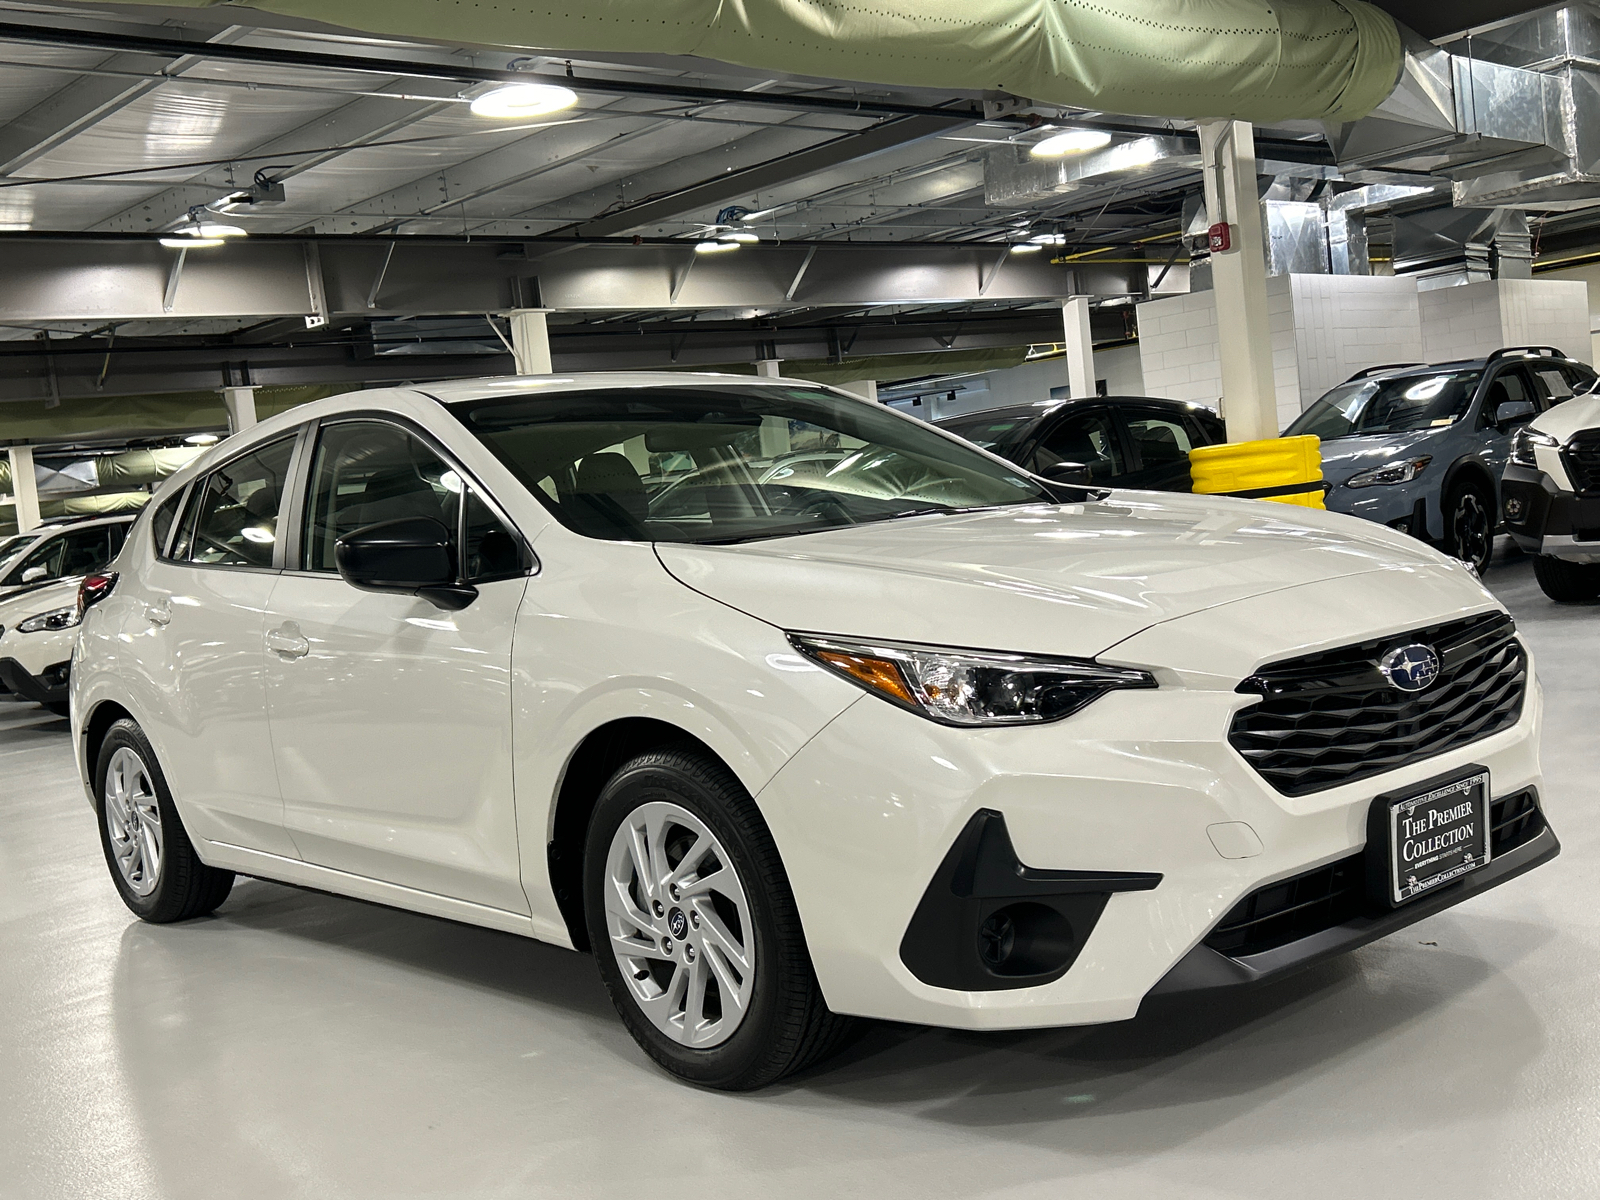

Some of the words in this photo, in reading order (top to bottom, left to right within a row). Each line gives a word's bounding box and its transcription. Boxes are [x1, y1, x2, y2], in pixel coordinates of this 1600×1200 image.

[1402, 817, 1427, 839] THE
[1428, 801, 1473, 830] PREMIER
[1403, 822, 1474, 862] COLLECTION
[1414, 855, 1439, 870] EVERYTHING
